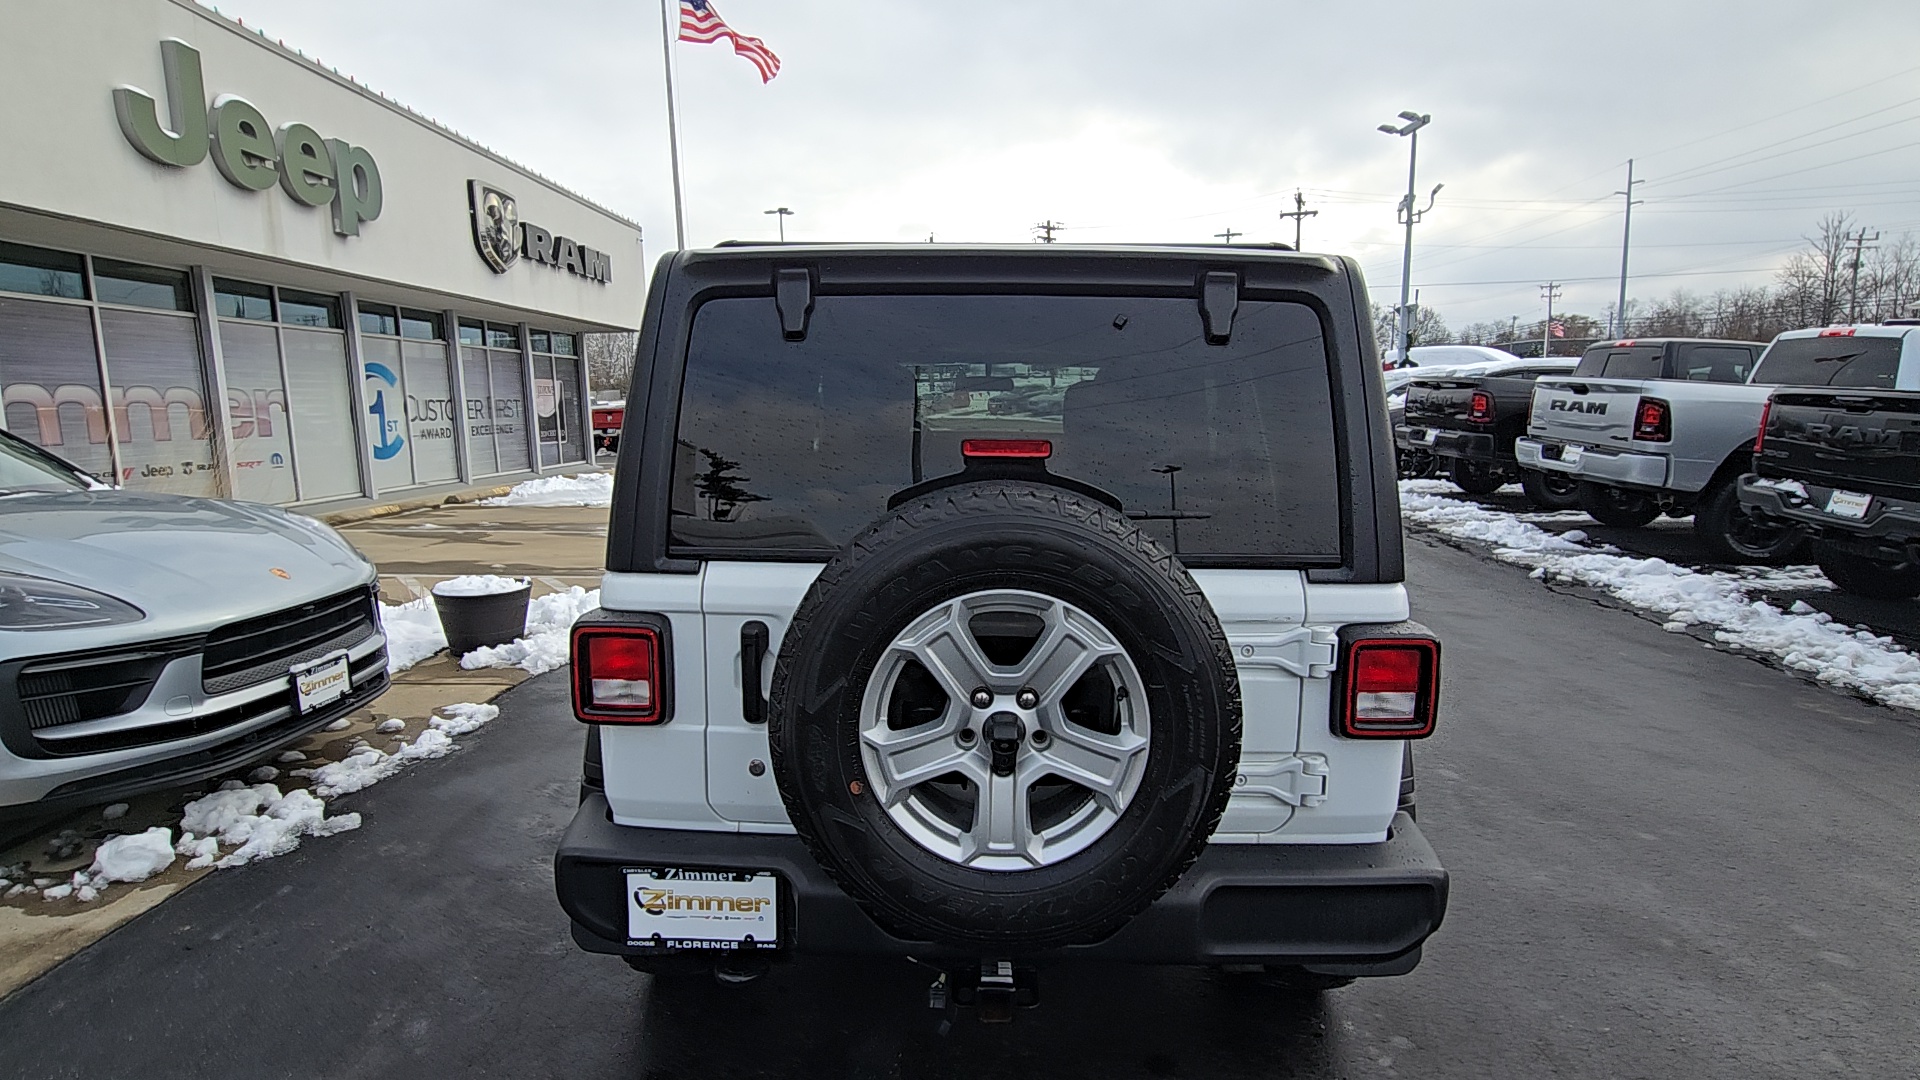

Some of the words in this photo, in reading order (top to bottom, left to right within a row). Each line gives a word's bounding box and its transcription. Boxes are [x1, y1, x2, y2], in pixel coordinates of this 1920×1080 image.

[113, 38, 384, 237] Jeep
[519, 221, 613, 284] RAM
[1550, 399, 1609, 416] RAM
[420, 427, 452, 439] AWARD
[1805, 422, 1901, 443] RAM
[141, 464, 173, 478] Jeep
[236, 460, 265, 469] SRT
[303, 671, 347, 693] Zimmer
[664, 867, 737, 882] Zimmer
[642, 888, 771, 913] Zimmer
[666, 940, 739, 950] FLORENCE
